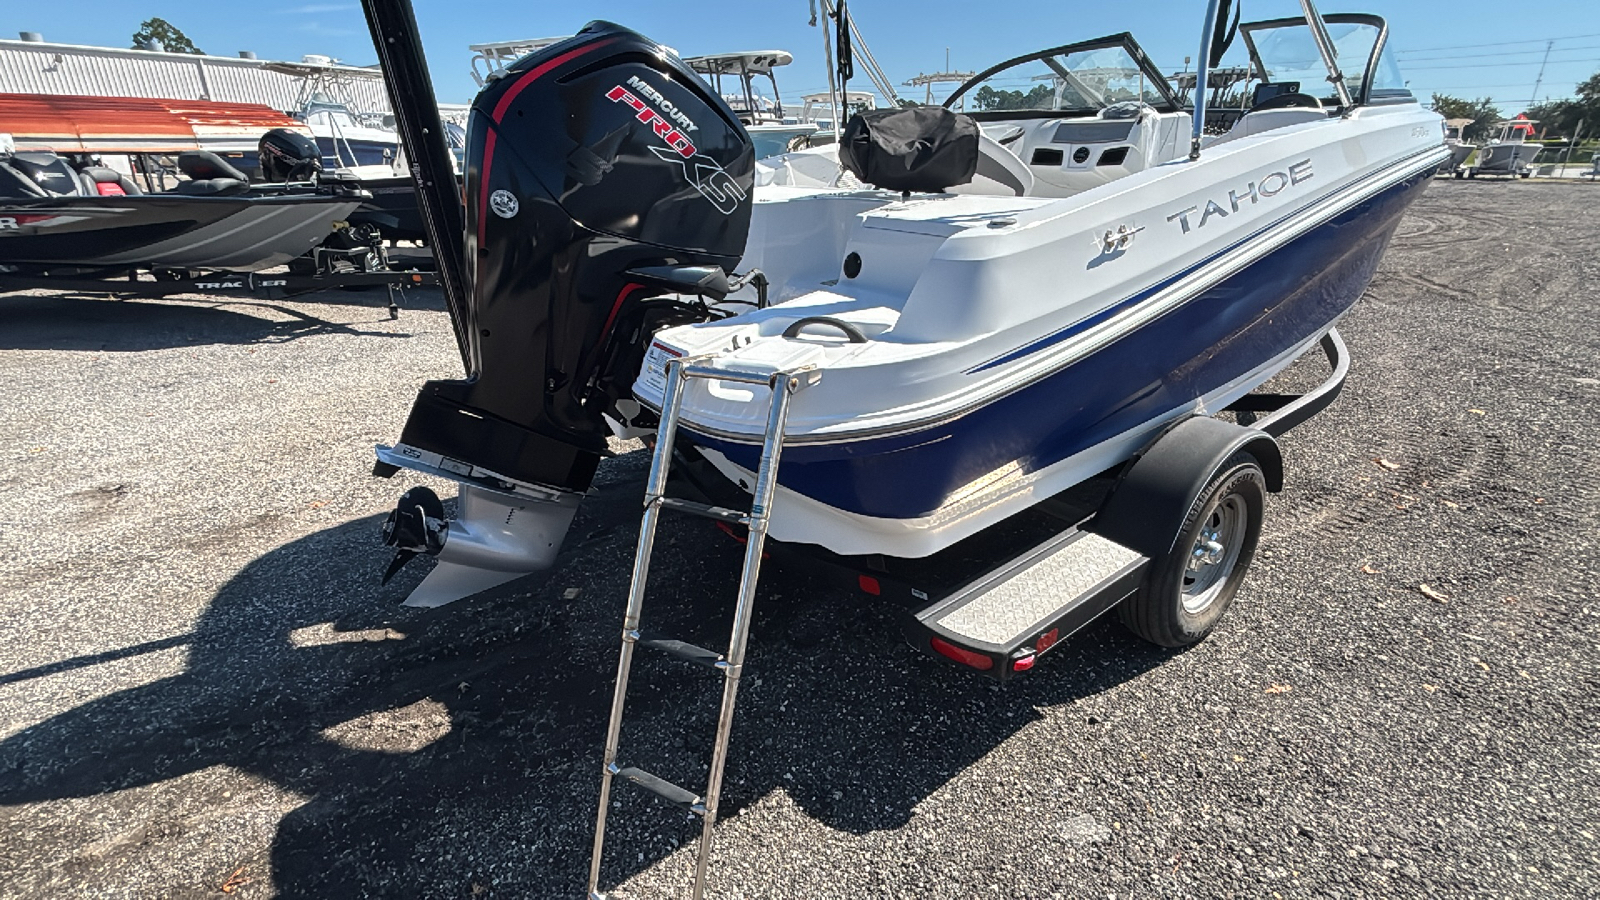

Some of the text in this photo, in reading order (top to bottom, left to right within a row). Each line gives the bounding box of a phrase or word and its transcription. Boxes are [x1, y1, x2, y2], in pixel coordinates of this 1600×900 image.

[605, 85, 698, 159] PRO
[626, 75, 699, 132] MERCURY
[647, 145, 747, 214] XS
[1166, 158, 1314, 235] TAHOE
[195, 280, 287, 289] TRACER
